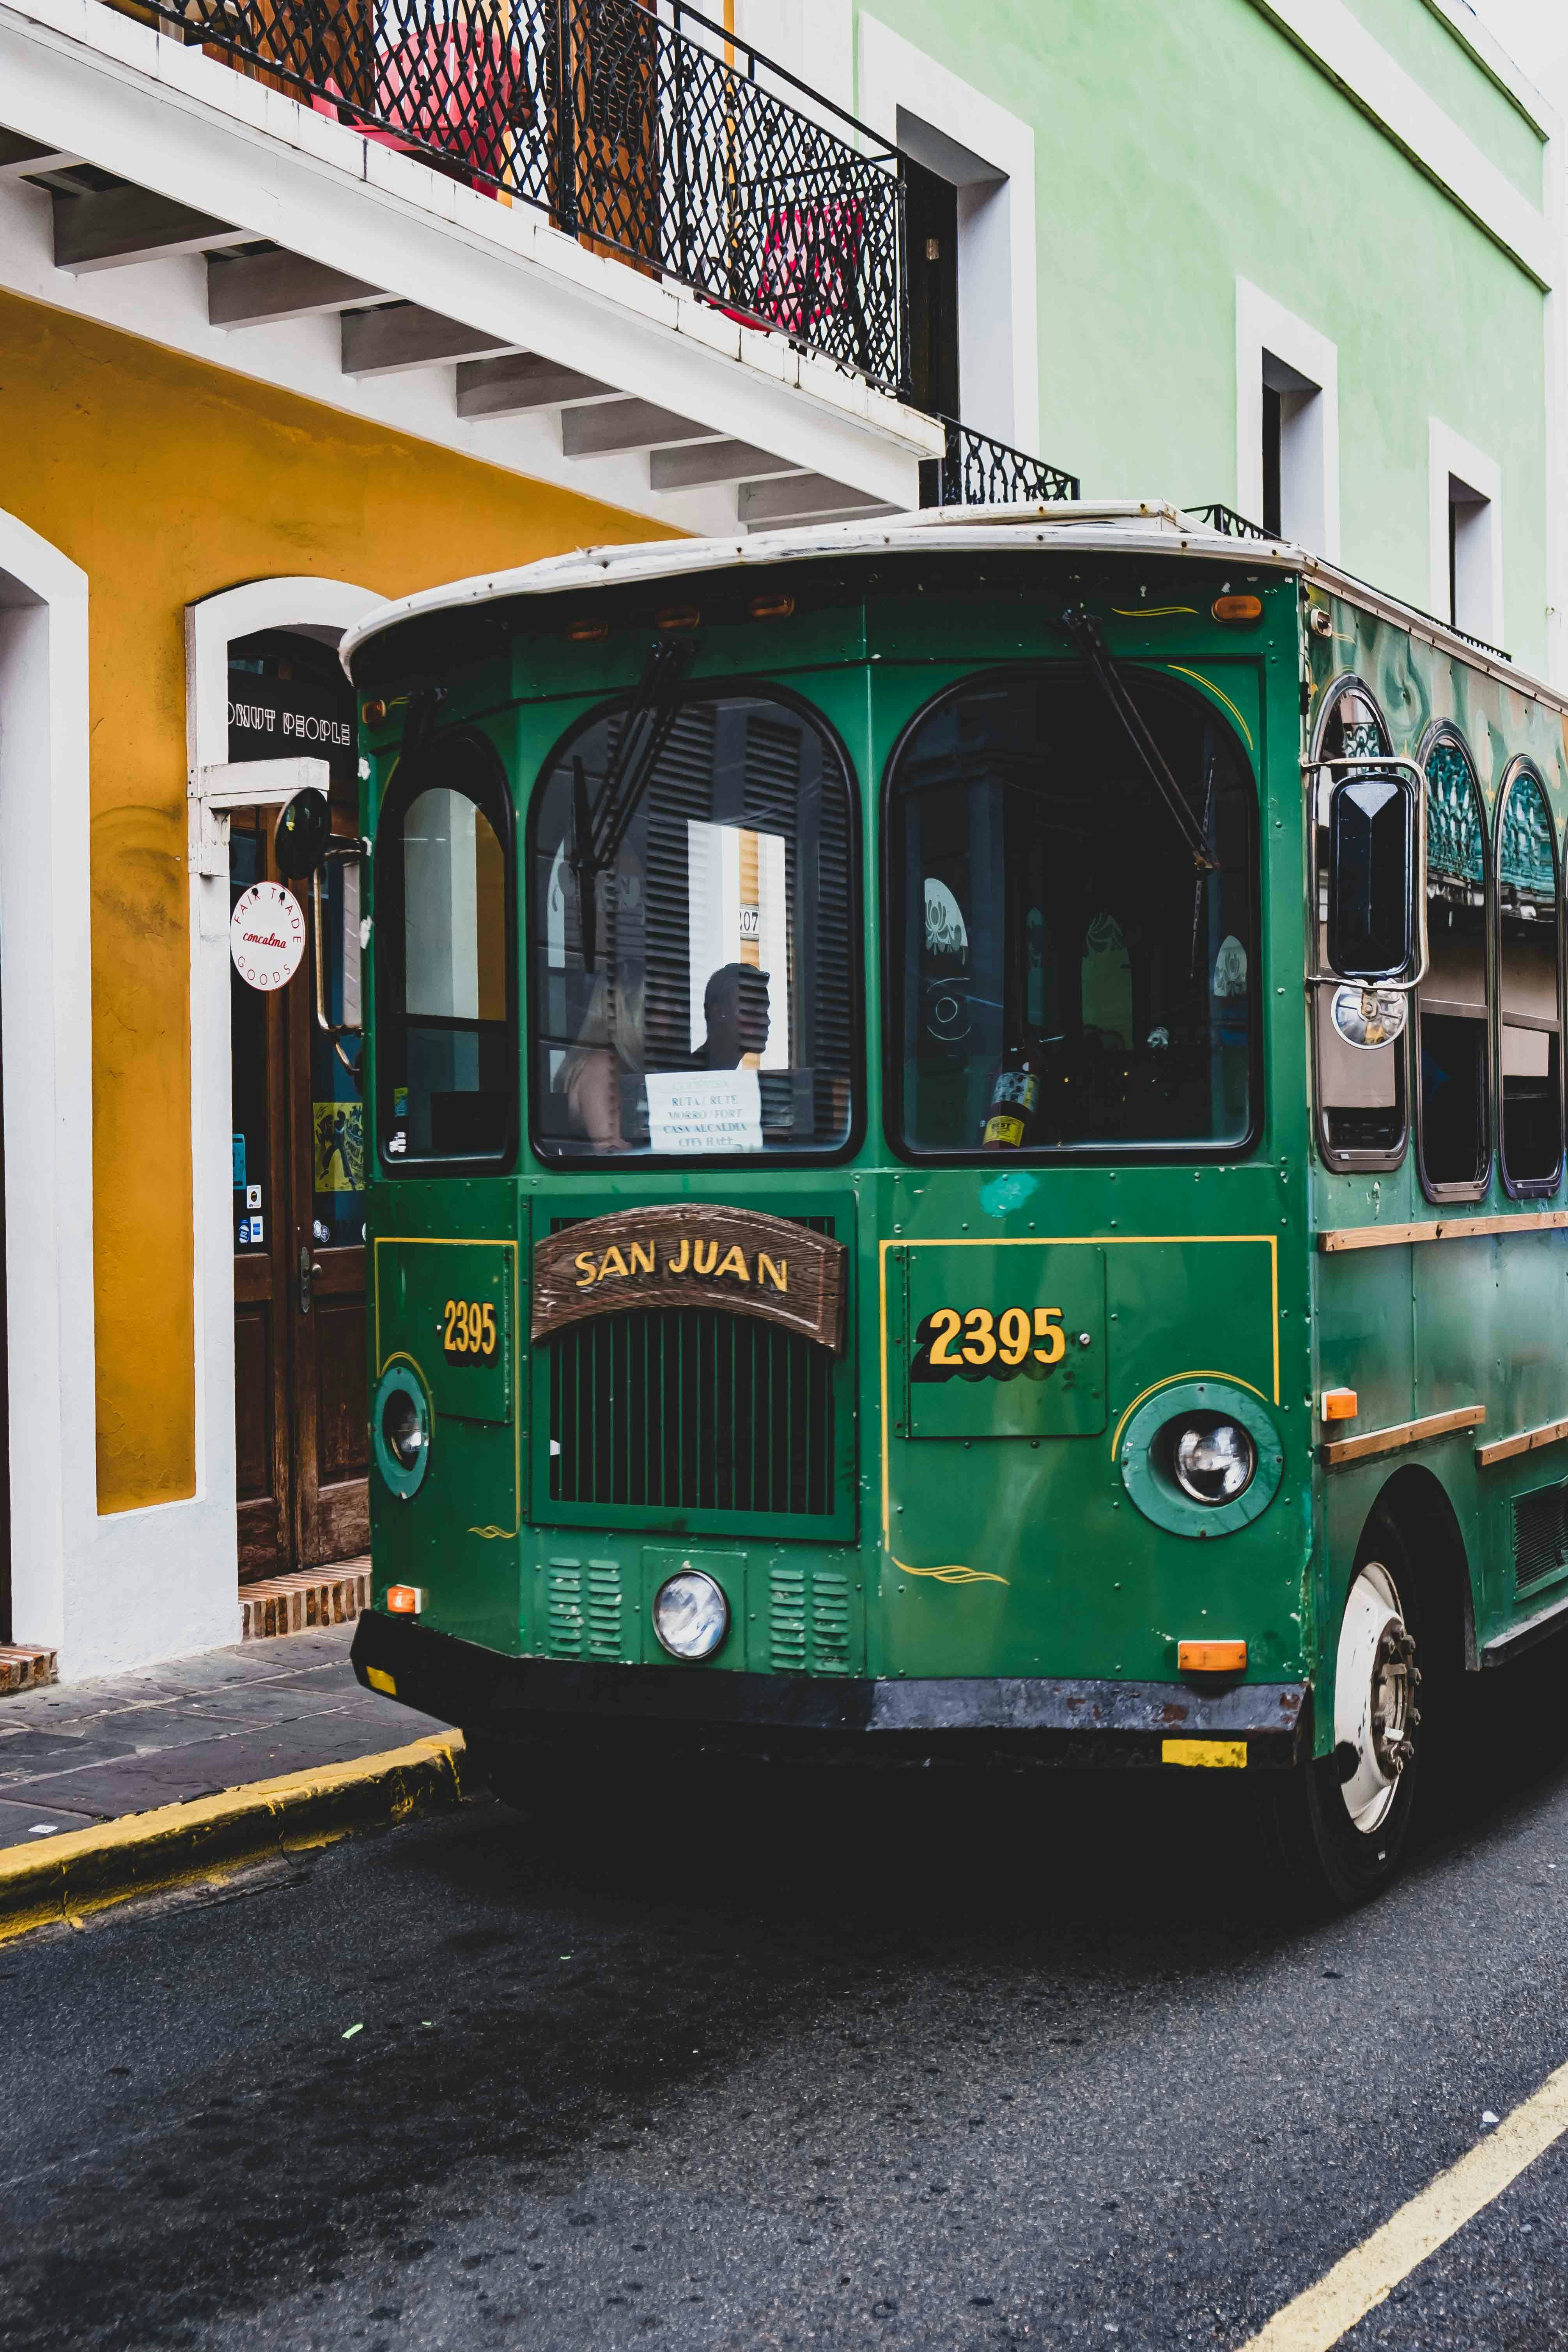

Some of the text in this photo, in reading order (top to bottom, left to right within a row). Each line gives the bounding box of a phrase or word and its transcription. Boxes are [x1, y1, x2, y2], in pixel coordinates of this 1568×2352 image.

[283, 712, 350, 746] PEOPLE
[243, 933, 287, 948] concalma
[237, 956, 291, 985] GOODS
[575, 1240, 788, 1292] SAN JUAN
[444, 1300, 496, 1355] 2395
[929, 1308, 1066, 1365] 2395
